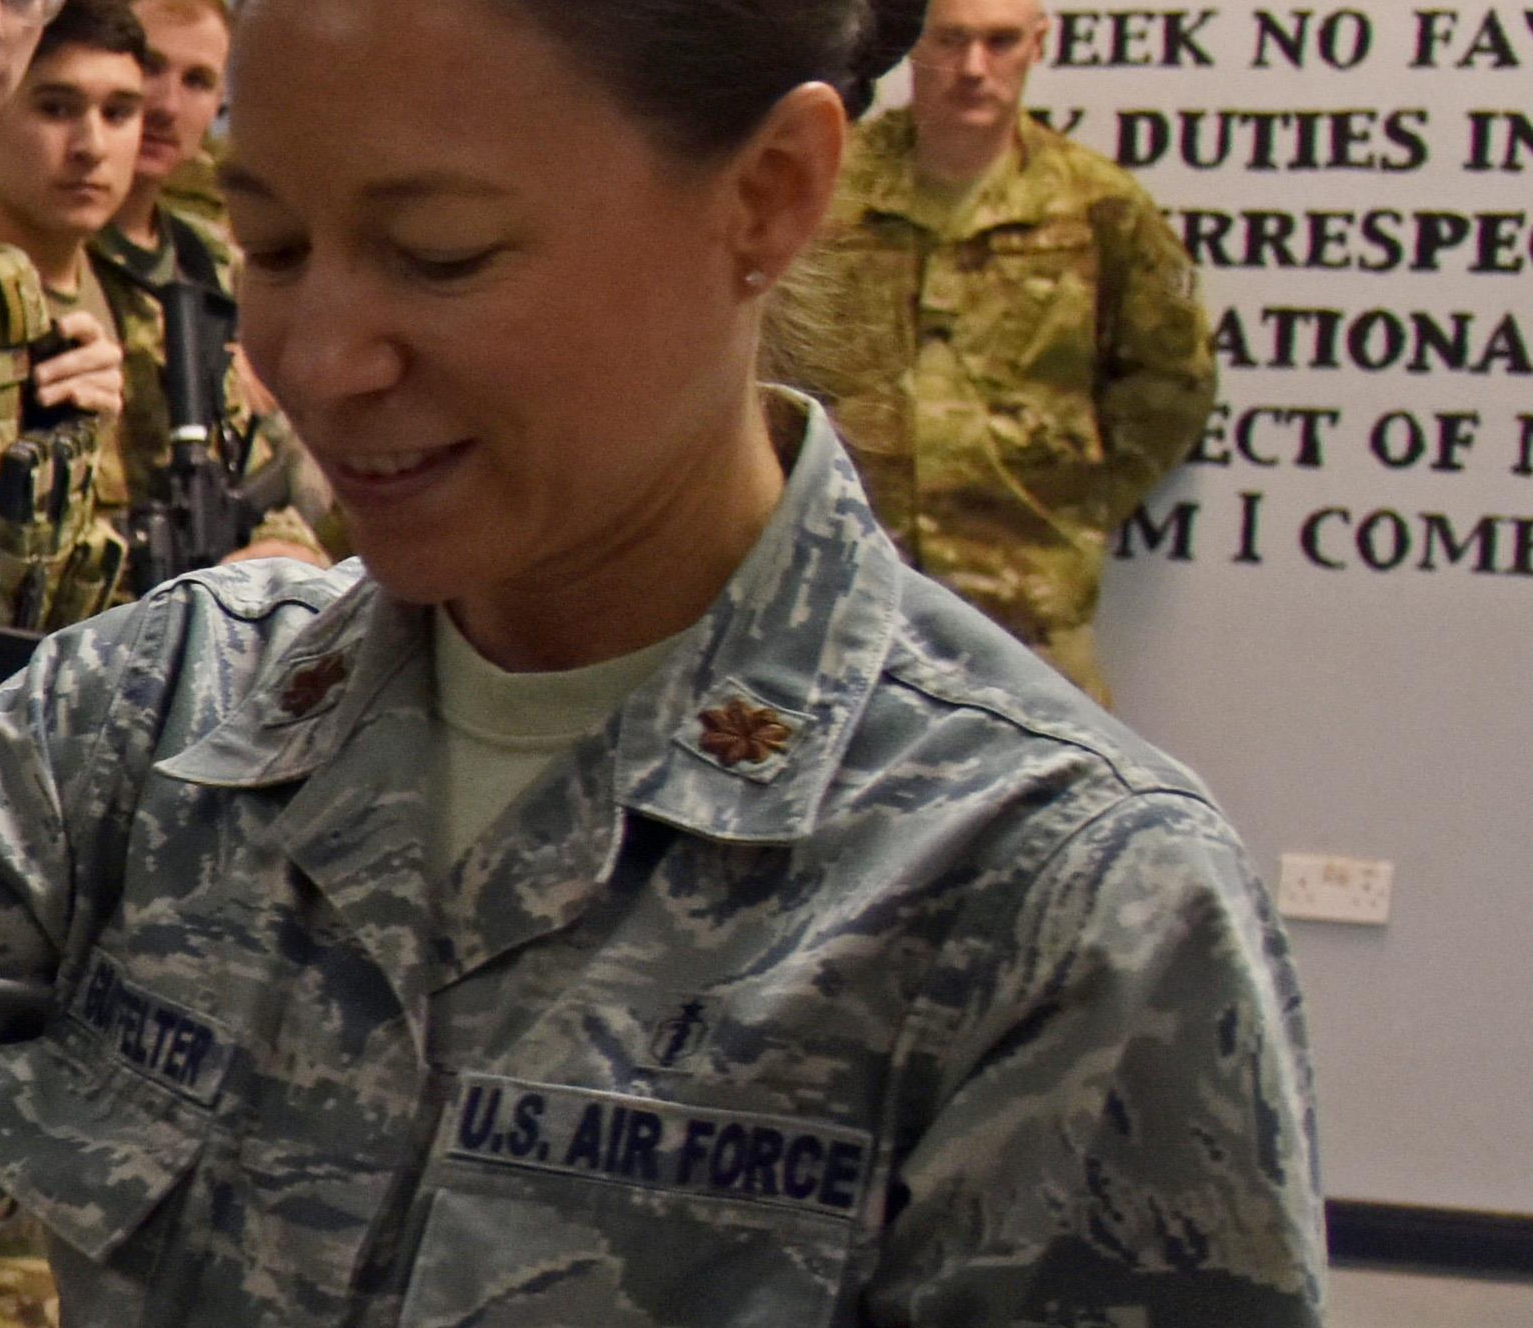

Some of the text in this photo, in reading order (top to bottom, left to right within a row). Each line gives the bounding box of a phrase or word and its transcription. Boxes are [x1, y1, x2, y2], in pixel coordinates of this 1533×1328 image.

[1252, 8, 1372, 70] NO
[1409, 8, 1533, 69] FA
[1114, 109, 1429, 172] DUTIES
[1161, 209, 1533, 273] RRESPE
[1369, 410, 1481, 472] OF
[1233, 491, 1264, 564] I
[459, 1084, 864, 1208] U.S. AIR FORCE
